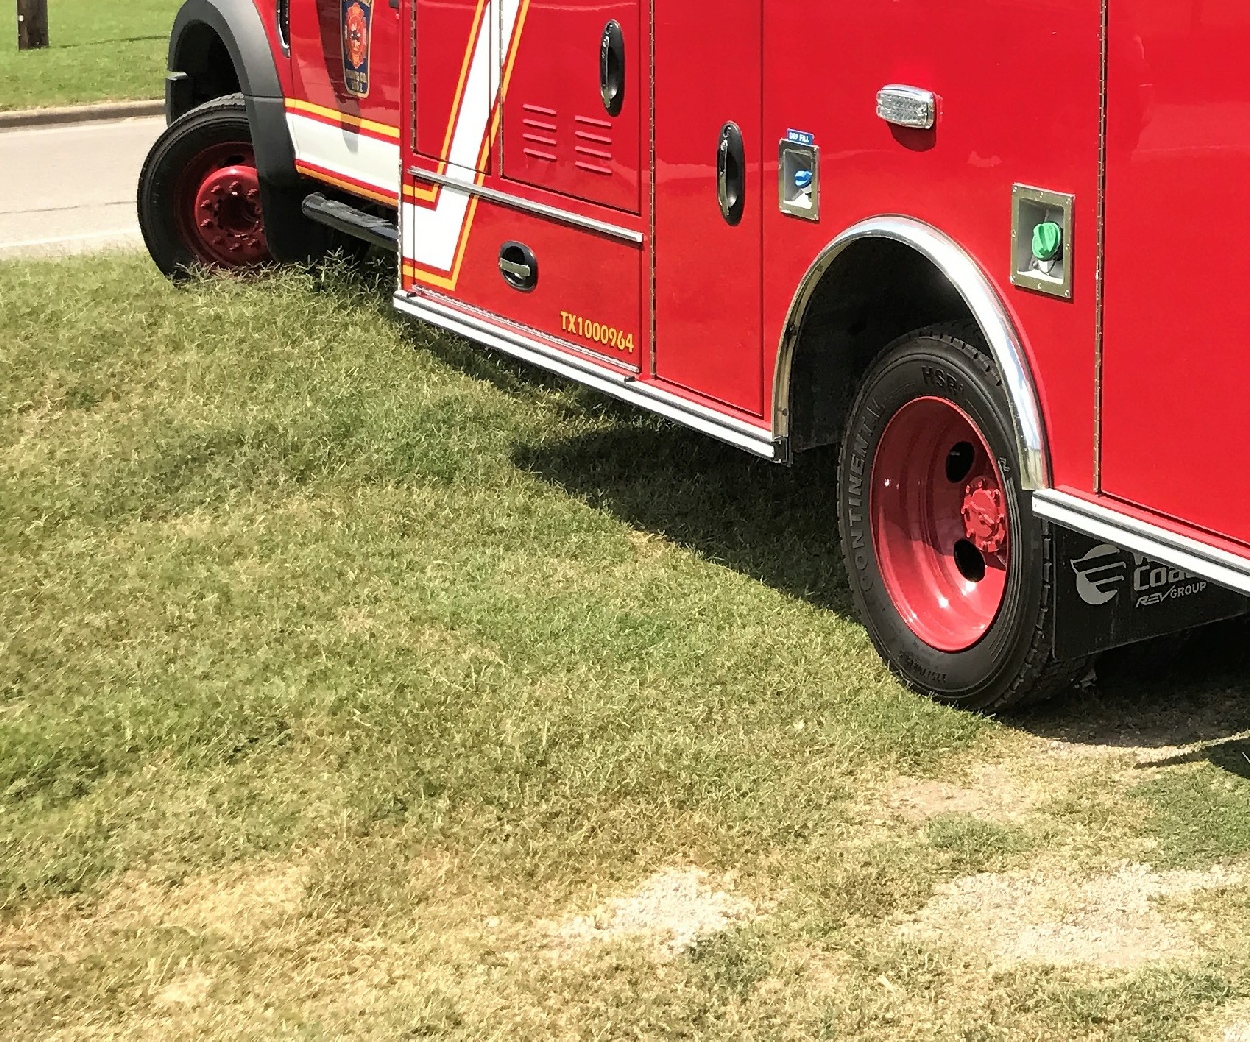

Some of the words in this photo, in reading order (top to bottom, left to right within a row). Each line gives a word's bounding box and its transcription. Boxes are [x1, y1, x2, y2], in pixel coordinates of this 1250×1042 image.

[560, 310, 635, 353] TX1000964
[848, 398, 885, 592] CONTINENT
[1170, 581, 1207, 599] GROUP
